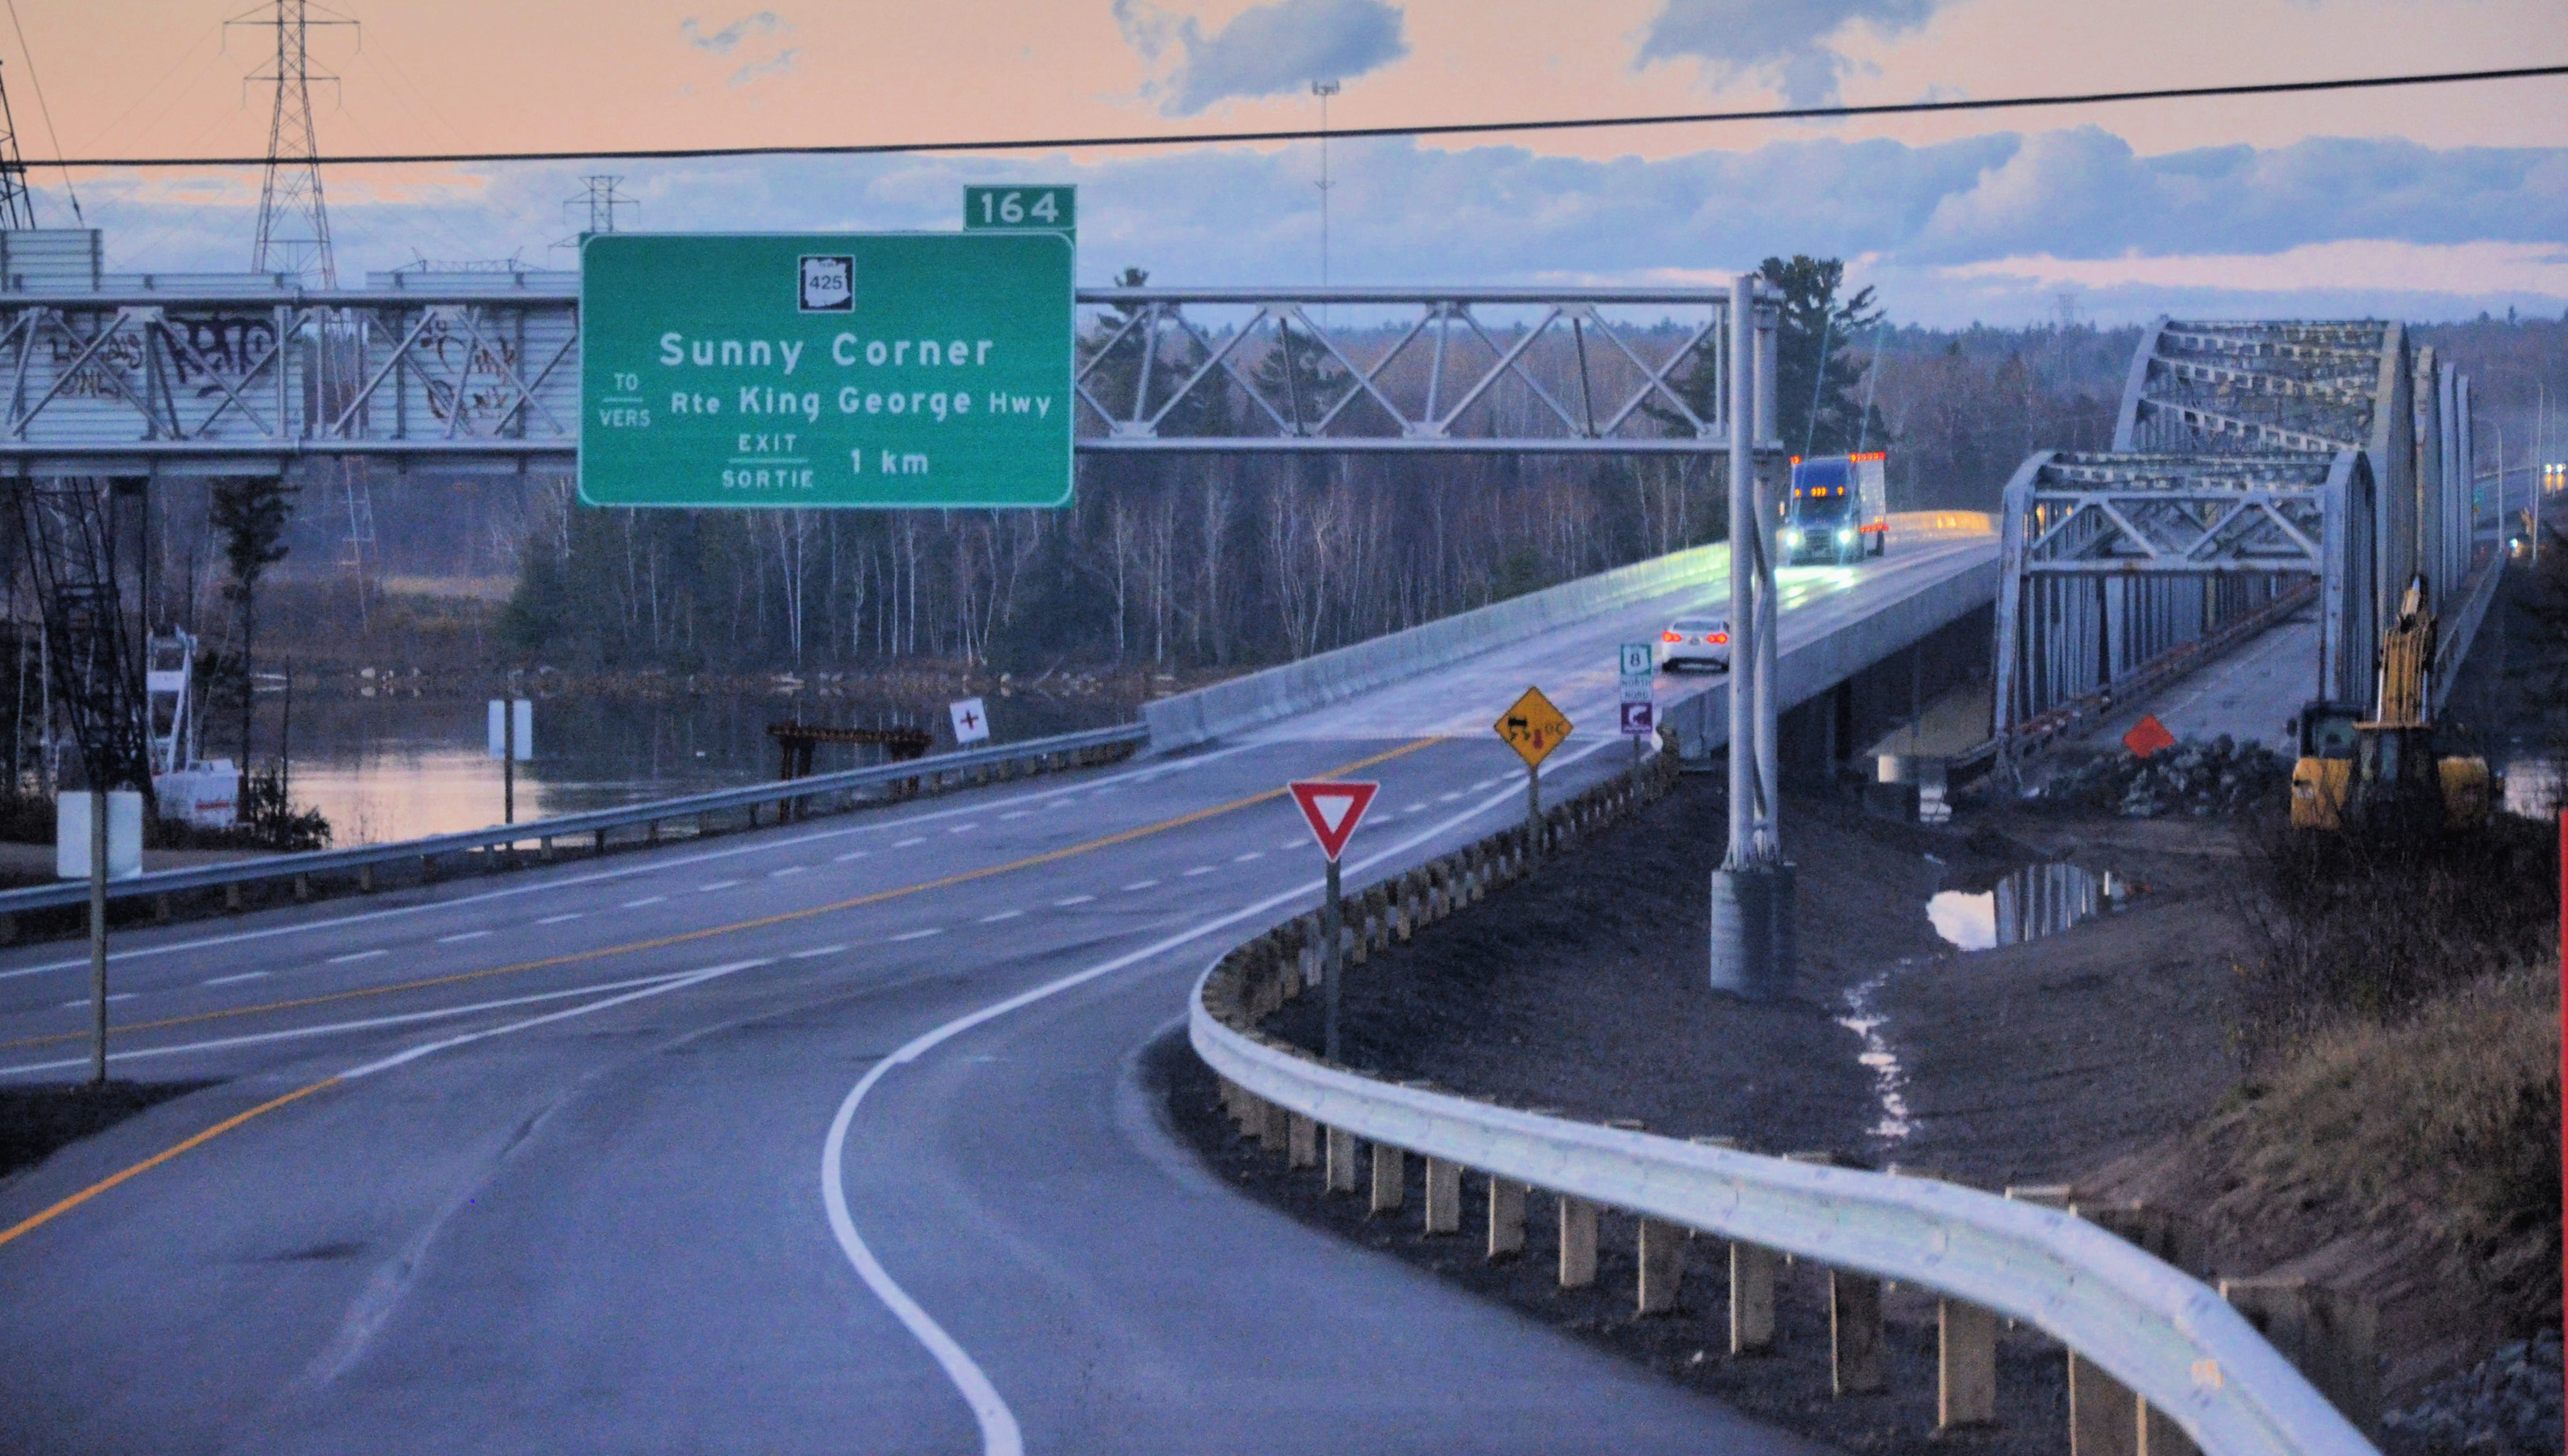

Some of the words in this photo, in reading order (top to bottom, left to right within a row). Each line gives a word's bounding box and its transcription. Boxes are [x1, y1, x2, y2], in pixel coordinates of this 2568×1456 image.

[981, 192, 1059, 223] 164
[809, 275, 842, 290] 425
[660, 332, 804, 375] Sunny
[832, 332, 993, 366] Corner
[614, 373, 639, 391] TO
[671, 392, 721, 414] Rte
[739, 386, 820, 422] King
[838, 386, 971, 422] George
[990, 392, 1051, 418] Hwy
[599, 408, 650, 428] VERS
[738, 434, 796, 452] EXIT
[851, 449, 860, 473] 1
[882, 450, 929, 474] km
[722, 469, 814, 488] SORTIE
[1631, 653, 1640, 667] 8
